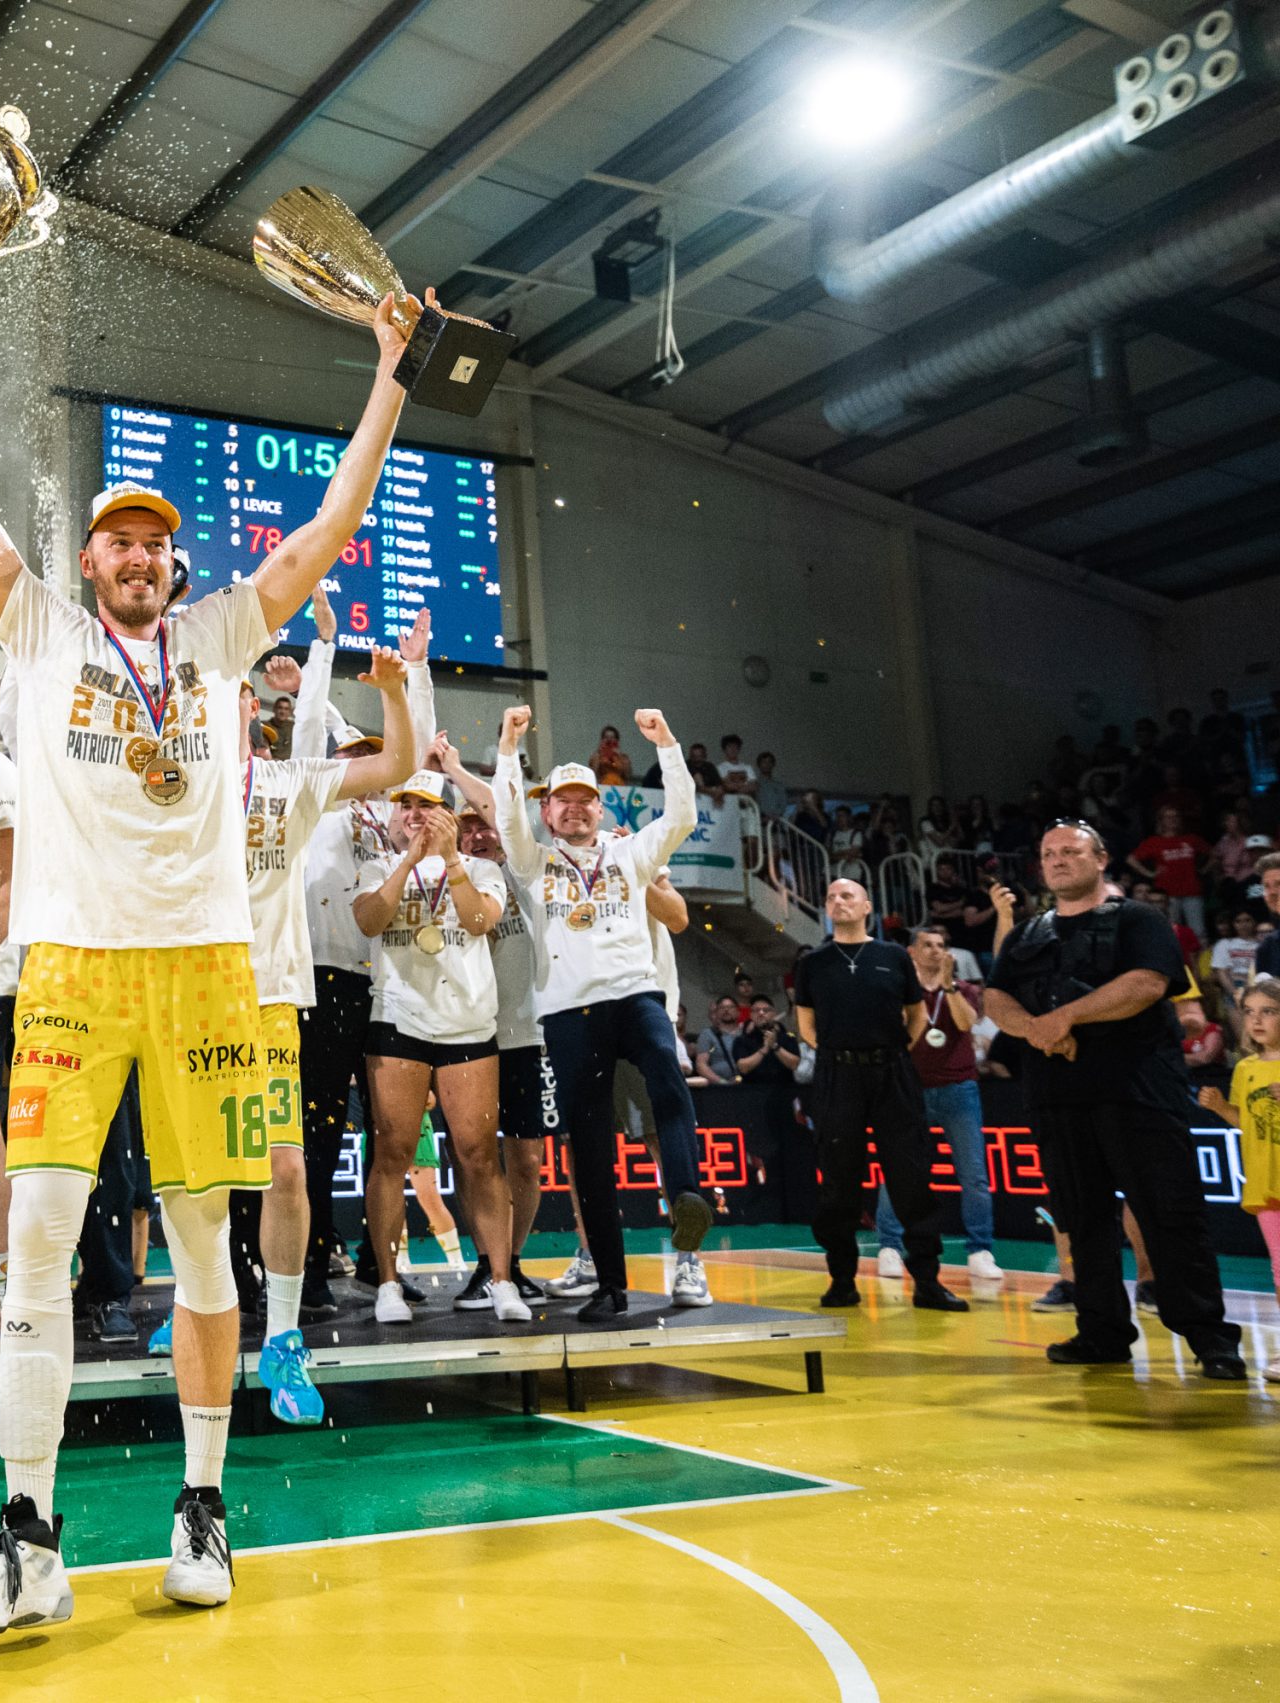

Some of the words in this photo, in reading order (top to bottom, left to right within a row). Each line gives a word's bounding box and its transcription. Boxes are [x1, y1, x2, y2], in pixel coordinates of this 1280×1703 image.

[111, 408, 121, 420] 0
[111, 426, 121, 438] 7
[228, 424, 238, 437] 5
[223, 442, 238, 455] 17
[255, 433, 346, 479] 01:5
[105, 462, 121, 476] 13
[229, 461, 239, 473] 4
[384, 465, 392, 477] 5
[480, 462, 494, 475] 17
[223, 478, 239, 491] 10
[244, 479, 256, 492] T
[384, 482, 393, 495] 7
[486, 479, 496, 492] 5
[243, 498, 283, 515] LEVICE
[380, 499, 394, 512] 10
[486, 496, 496, 510] 2
[230, 515, 240, 528] 3
[382, 517, 394, 529] 11
[487, 514, 497, 526] 4
[246, 524, 282, 554] 78
[381, 535, 395, 547] 17
[488, 530, 498, 543] 7
[340, 537, 372, 567] 61
[381, 552, 396, 565] 20
[382, 570, 396, 583] 21
[383, 587, 398, 601] 23
[349, 601, 369, 632] 5
[383, 605, 399, 619] 25
[339, 634, 376, 650] FAULY
[494, 634, 504, 648] 2
[66, 729, 123, 765] PATRIOTI
[164, 732, 210, 763] LEVICE
[599, 902, 630, 919] LEVICE
[36, 1016, 89, 1034] VEOLIA
[27, 1050, 82, 1071] KaMi
[187, 1038, 257, 1073] SÝPKA
[267, 1048, 298, 1066] PKA
[198, 1069, 265, 1082] PATRIOT
[540, 1044, 560, 1129] adid
[268, 1078, 301, 1128] 31
[220, 1093, 268, 1159] 18
